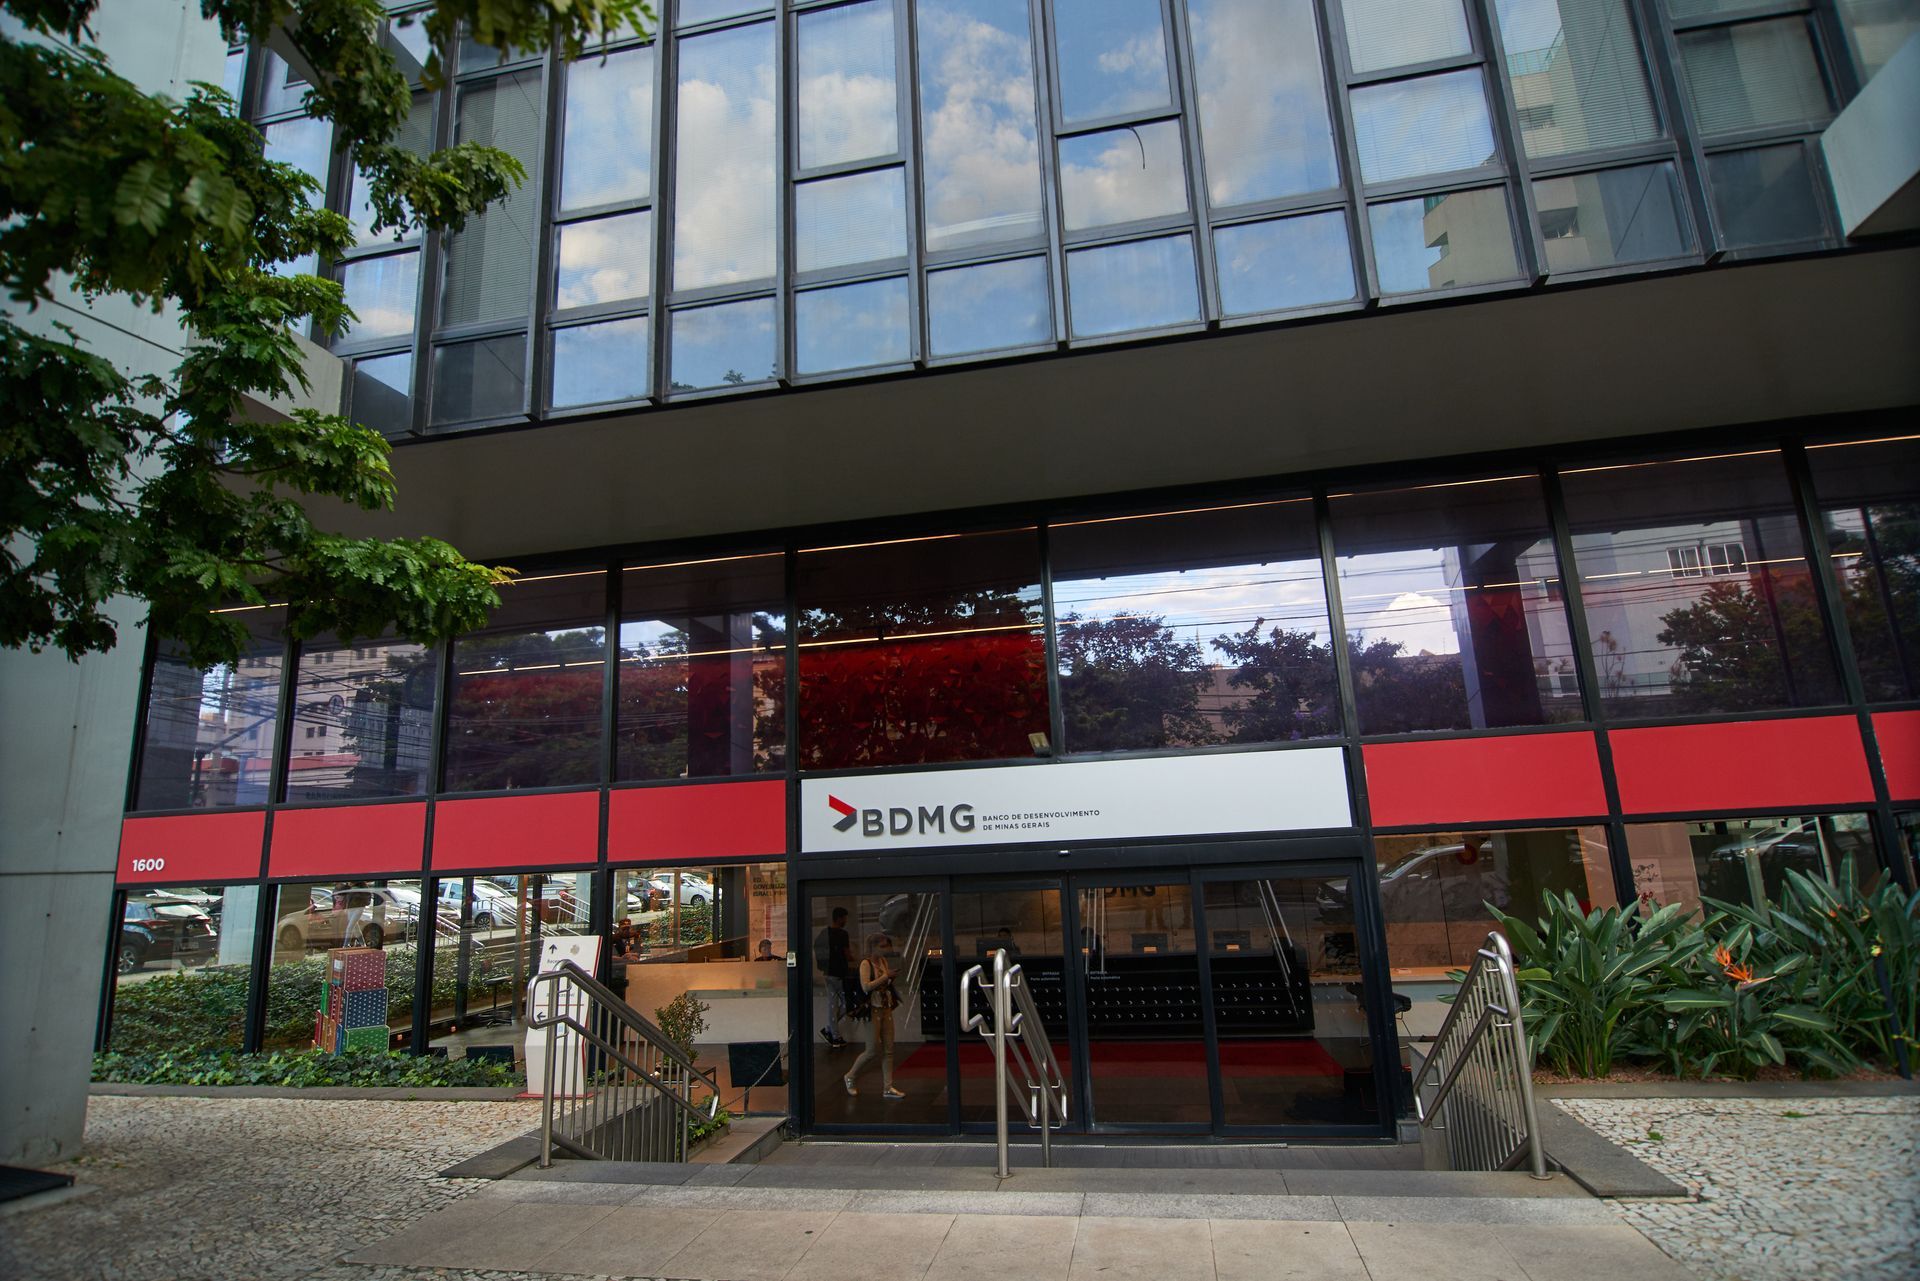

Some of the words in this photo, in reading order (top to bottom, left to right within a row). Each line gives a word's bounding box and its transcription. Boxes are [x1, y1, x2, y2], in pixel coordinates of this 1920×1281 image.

[862, 803, 975, 837] BDMG
[1024, 809, 1100, 820] DESENVOLVIMENTO
[132, 858, 165, 872] 1600
